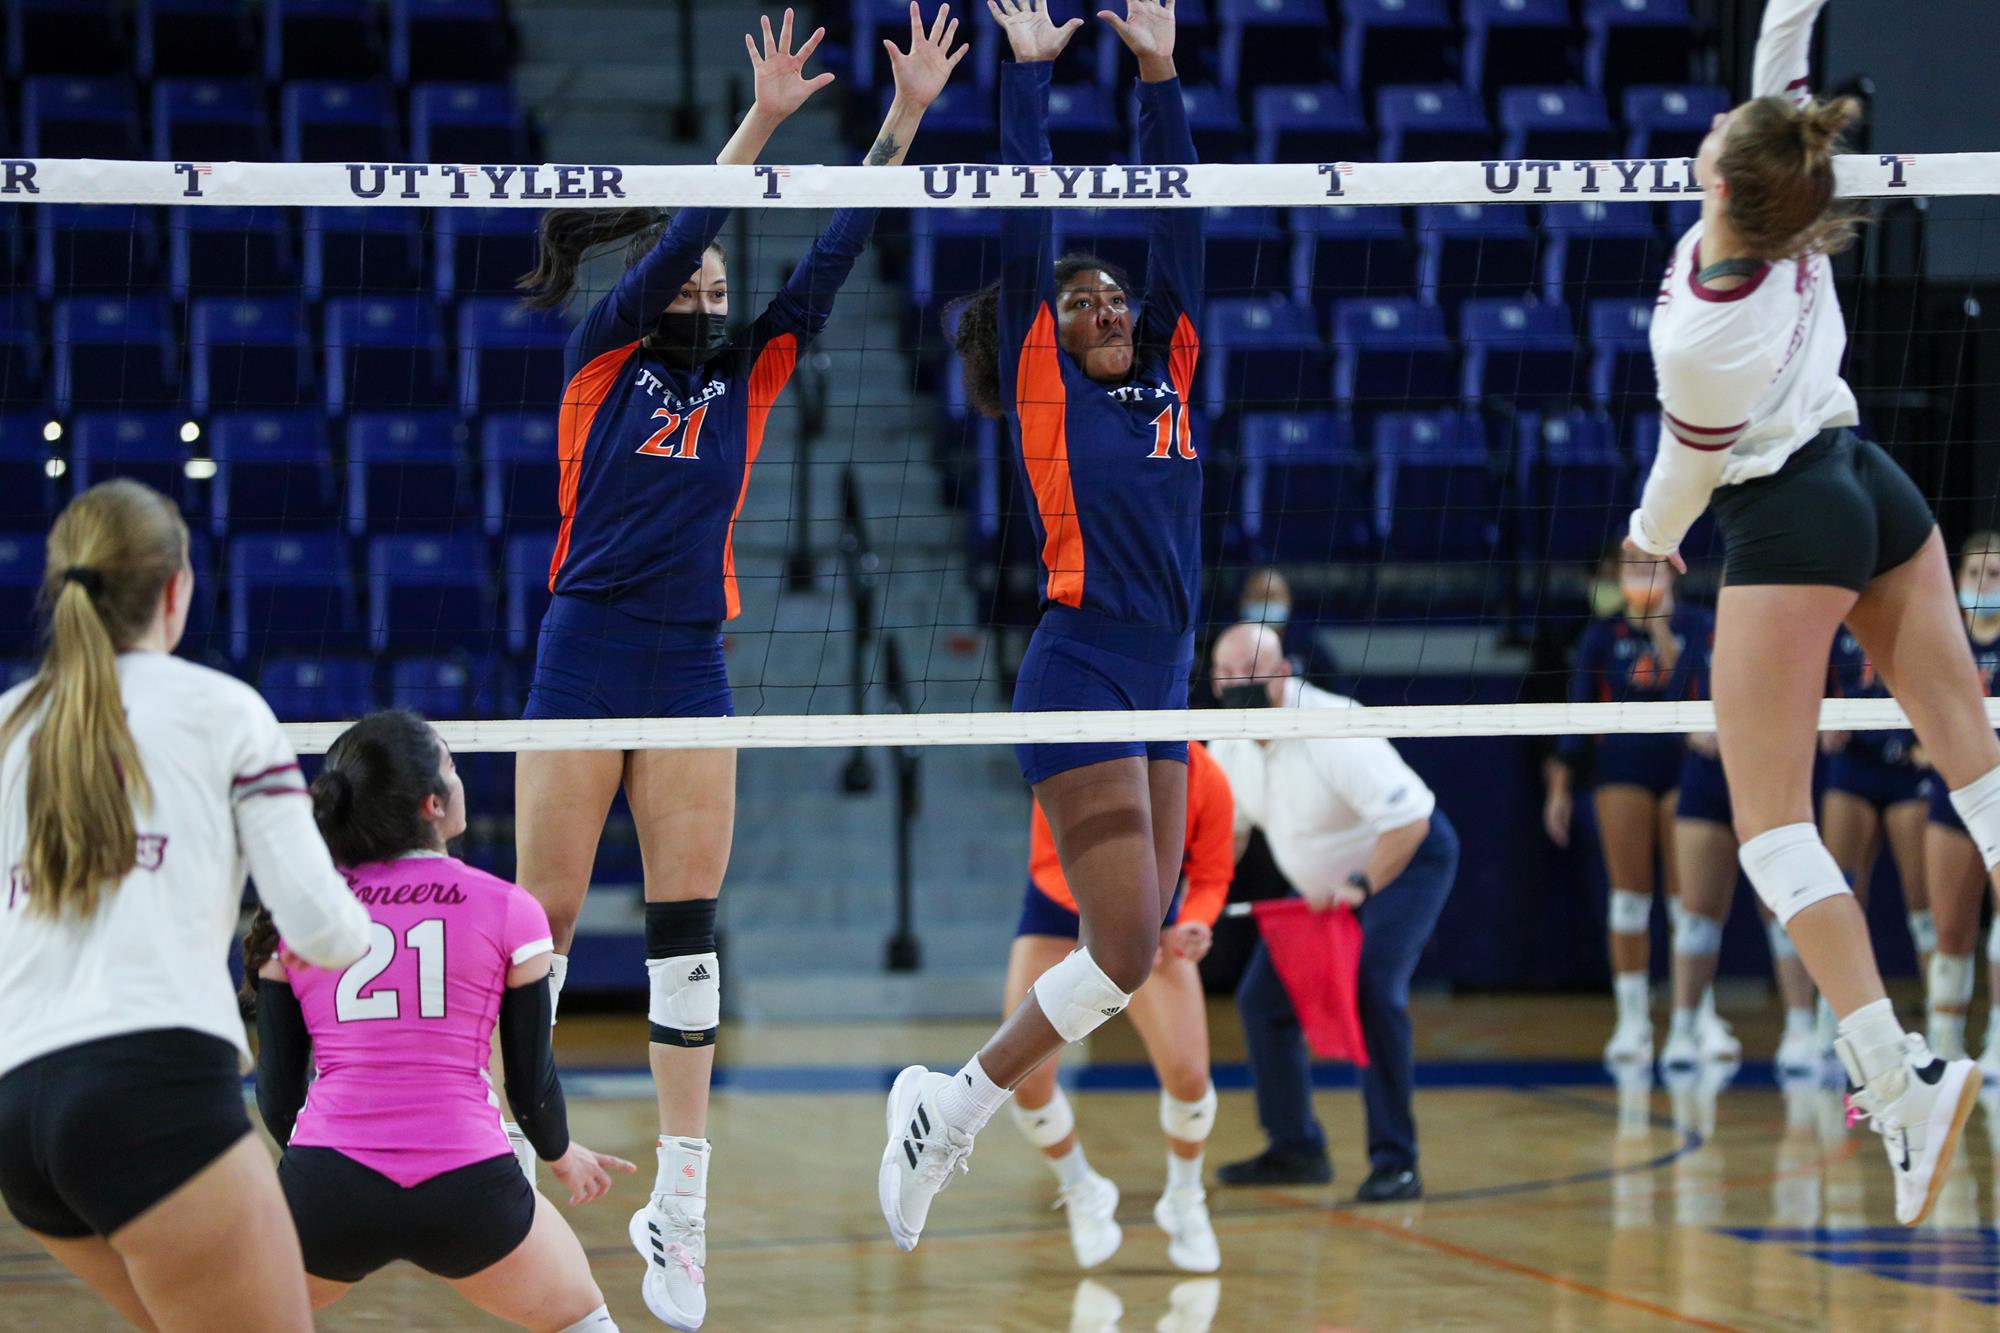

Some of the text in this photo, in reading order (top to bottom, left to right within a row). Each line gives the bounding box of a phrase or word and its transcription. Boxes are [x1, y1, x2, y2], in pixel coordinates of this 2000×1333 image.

[174, 163, 212, 197] T
[345, 165, 625, 199] UT TYLER
[755, 166, 791, 199] T
[919, 166, 1191, 199] UT TYLER
[1318, 164, 1353, 196] T
[1481, 159, 1702, 194] UT TYL
[1880, 155, 1916, 188] T
[635, 402, 709, 460] 21
[345, 873, 467, 905] oneers
[335, 918, 446, 1024] 21
